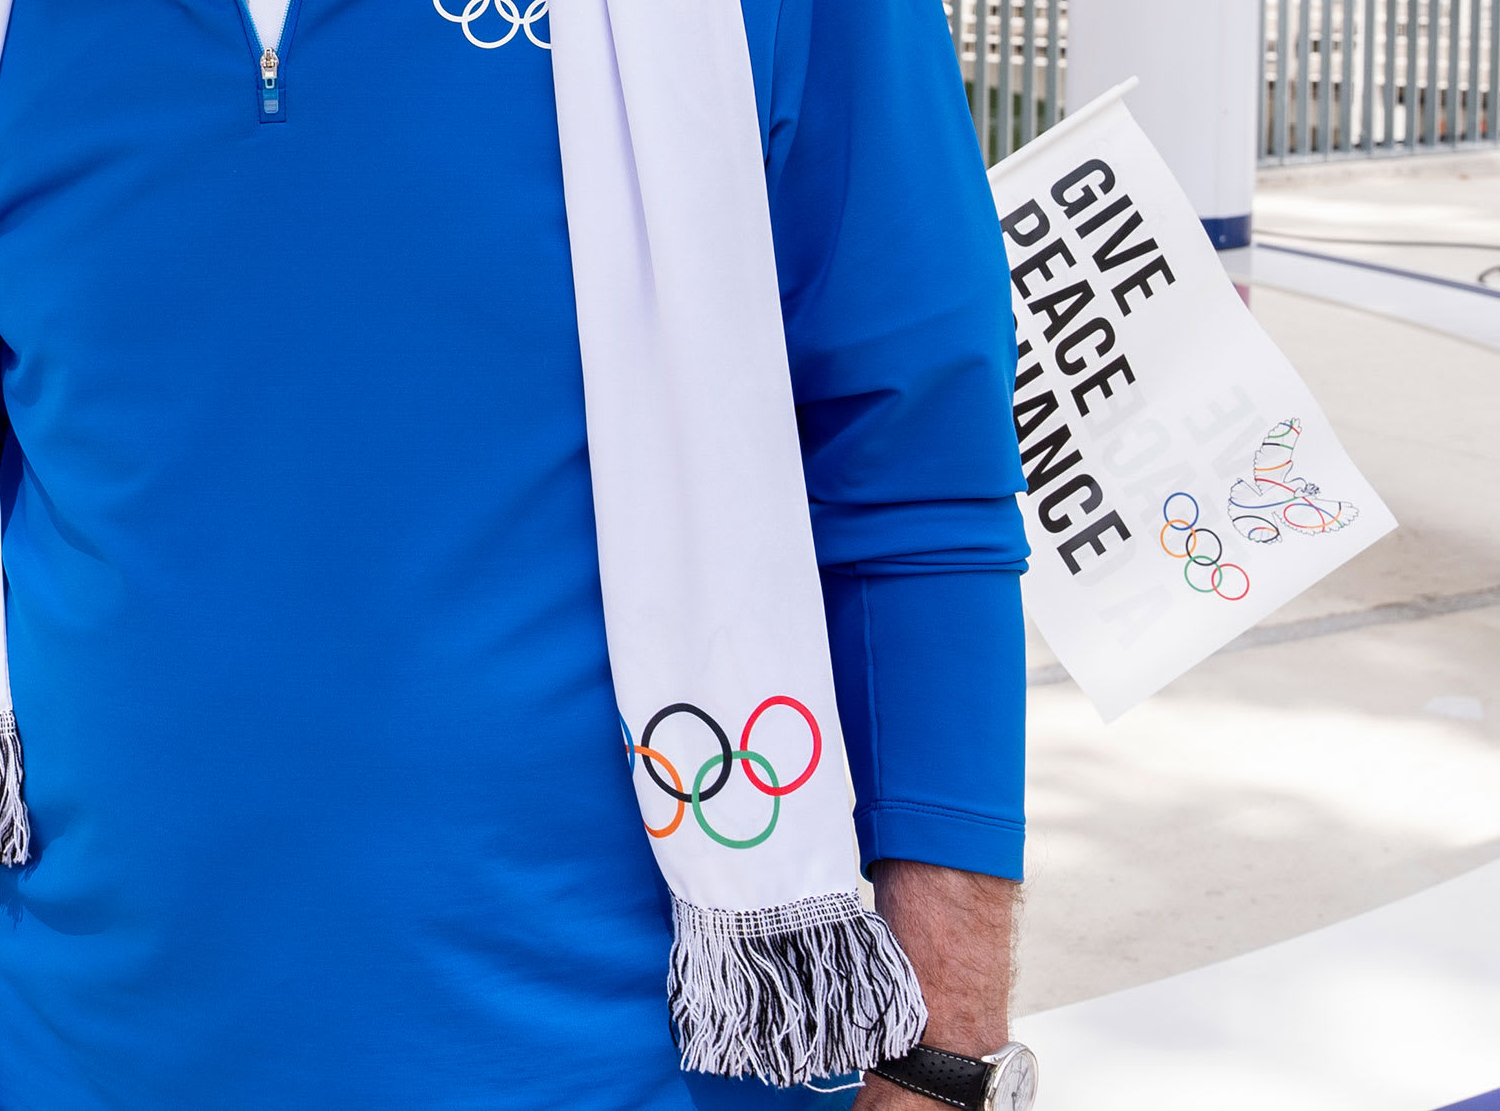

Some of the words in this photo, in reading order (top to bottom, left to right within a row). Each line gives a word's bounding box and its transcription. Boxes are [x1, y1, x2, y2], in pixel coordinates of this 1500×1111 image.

[999, 197, 1137, 419] PEACE
[1049, 157, 1177, 317] GIVE
[1013, 311, 1133, 578] ANCE
